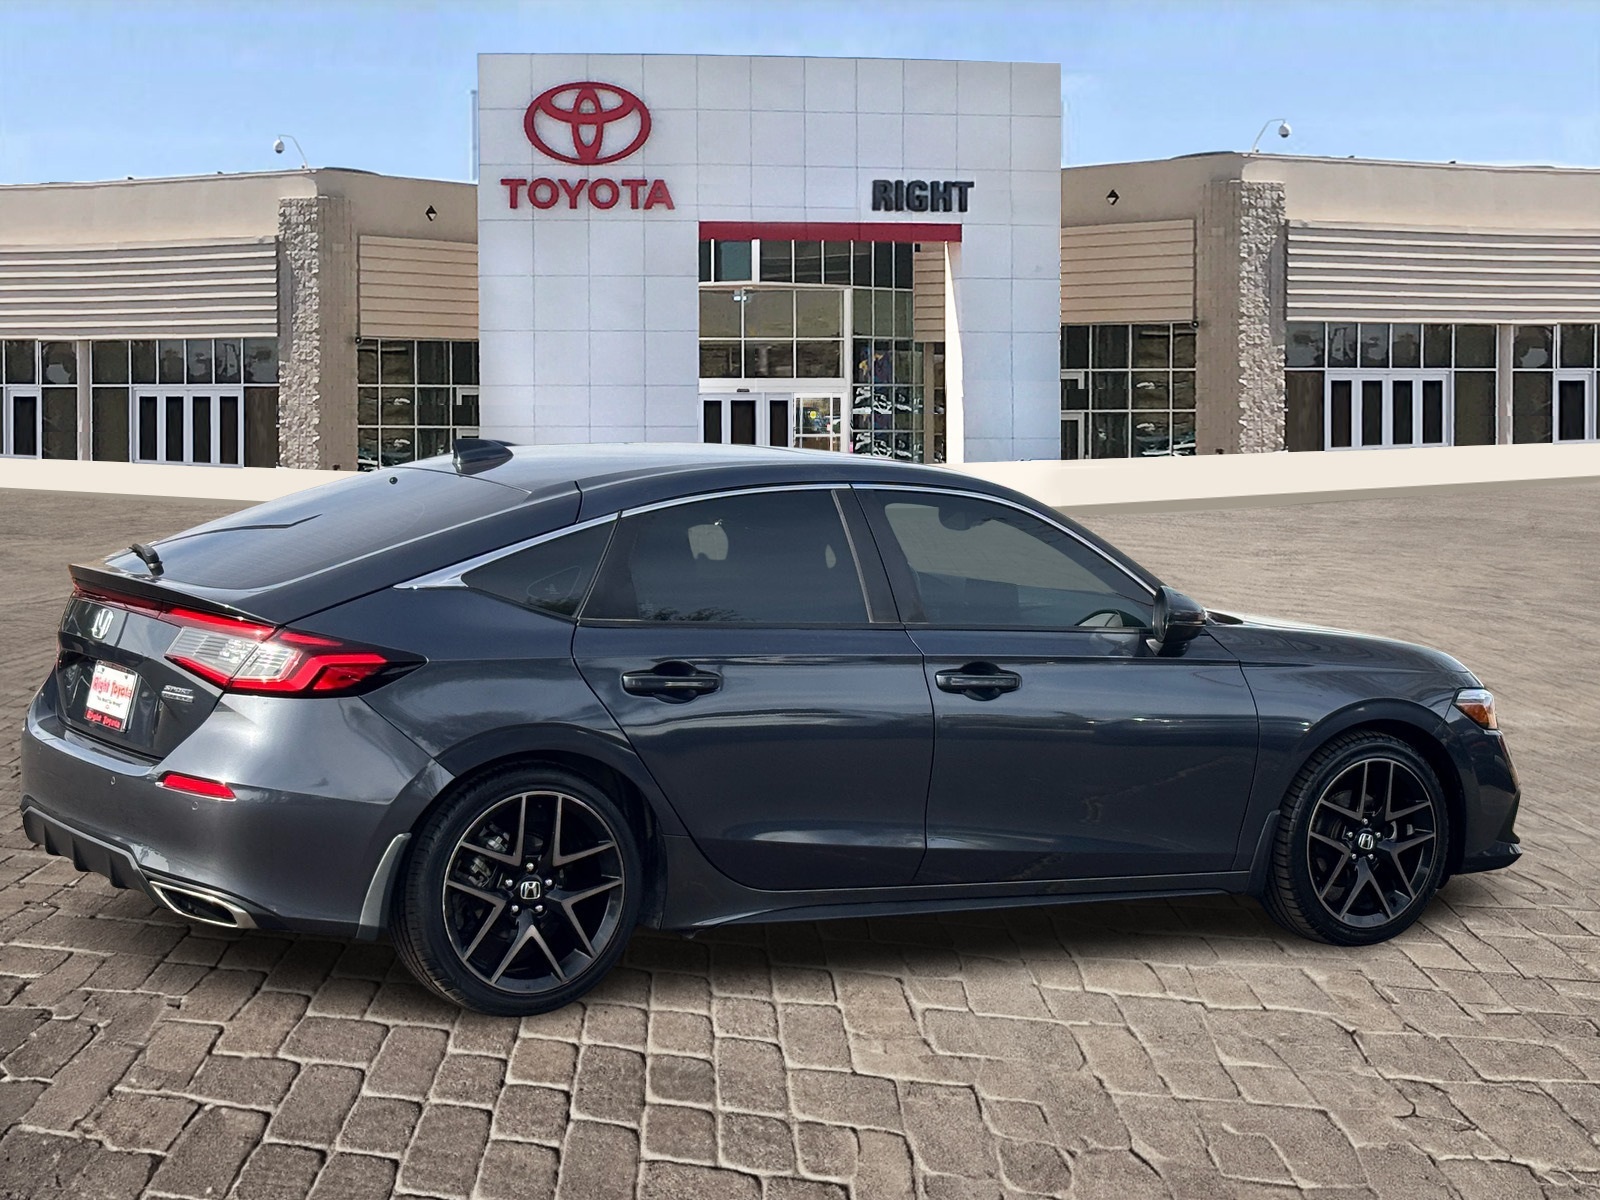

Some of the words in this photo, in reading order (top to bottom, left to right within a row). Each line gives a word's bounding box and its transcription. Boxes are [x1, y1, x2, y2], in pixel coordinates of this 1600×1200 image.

[500, 177, 675, 210] TOYOTA
[871, 179, 975, 212] RIGHT
[93, 676, 110, 694] Right
[111, 680, 132, 698] Toyota
[163, 684, 193, 694] SPORT
[86, 710, 102, 721] Right
[102, 715, 121, 729] Toyota
